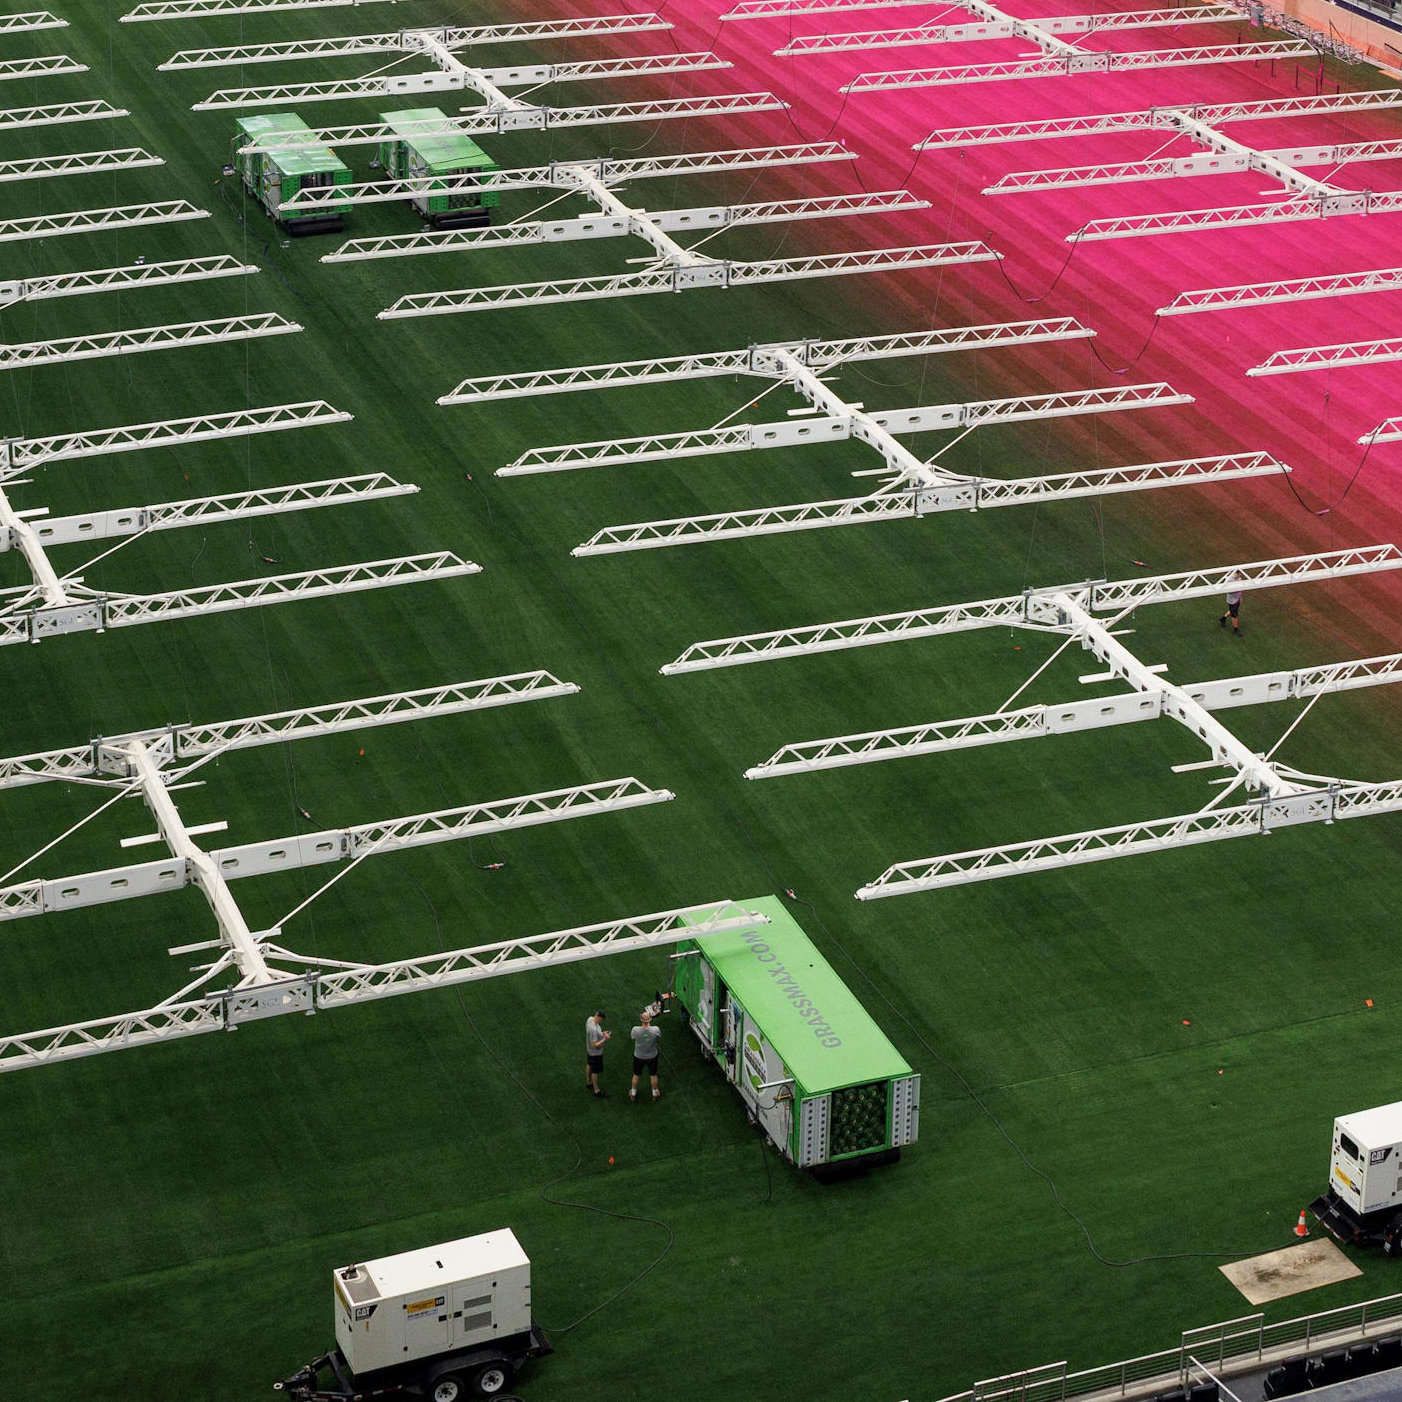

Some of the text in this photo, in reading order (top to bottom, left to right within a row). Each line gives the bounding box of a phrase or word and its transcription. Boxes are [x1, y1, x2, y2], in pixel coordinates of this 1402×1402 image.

[740, 930, 842, 1049] GRASSMAX.COM
[1371, 1149, 1386, 1161] CAT
[356, 1307, 370, 1317] CAT
